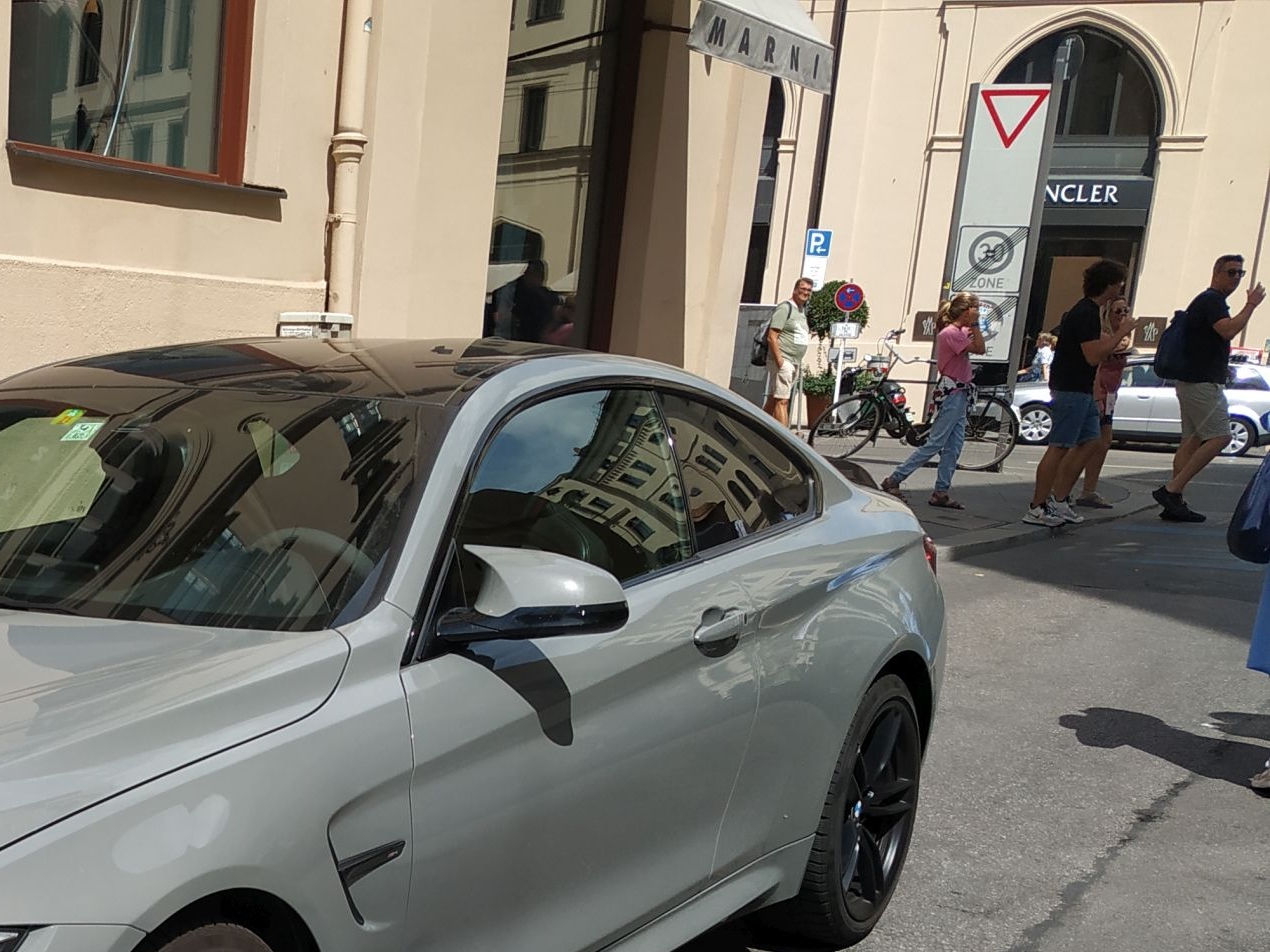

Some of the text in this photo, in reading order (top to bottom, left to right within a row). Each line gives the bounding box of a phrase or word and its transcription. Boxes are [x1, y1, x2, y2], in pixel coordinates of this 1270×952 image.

[707, 16, 820, 80] MARNI
[1045, 184, 1119, 203] NCLER
[970, 277, 1005, 289] ZONE
